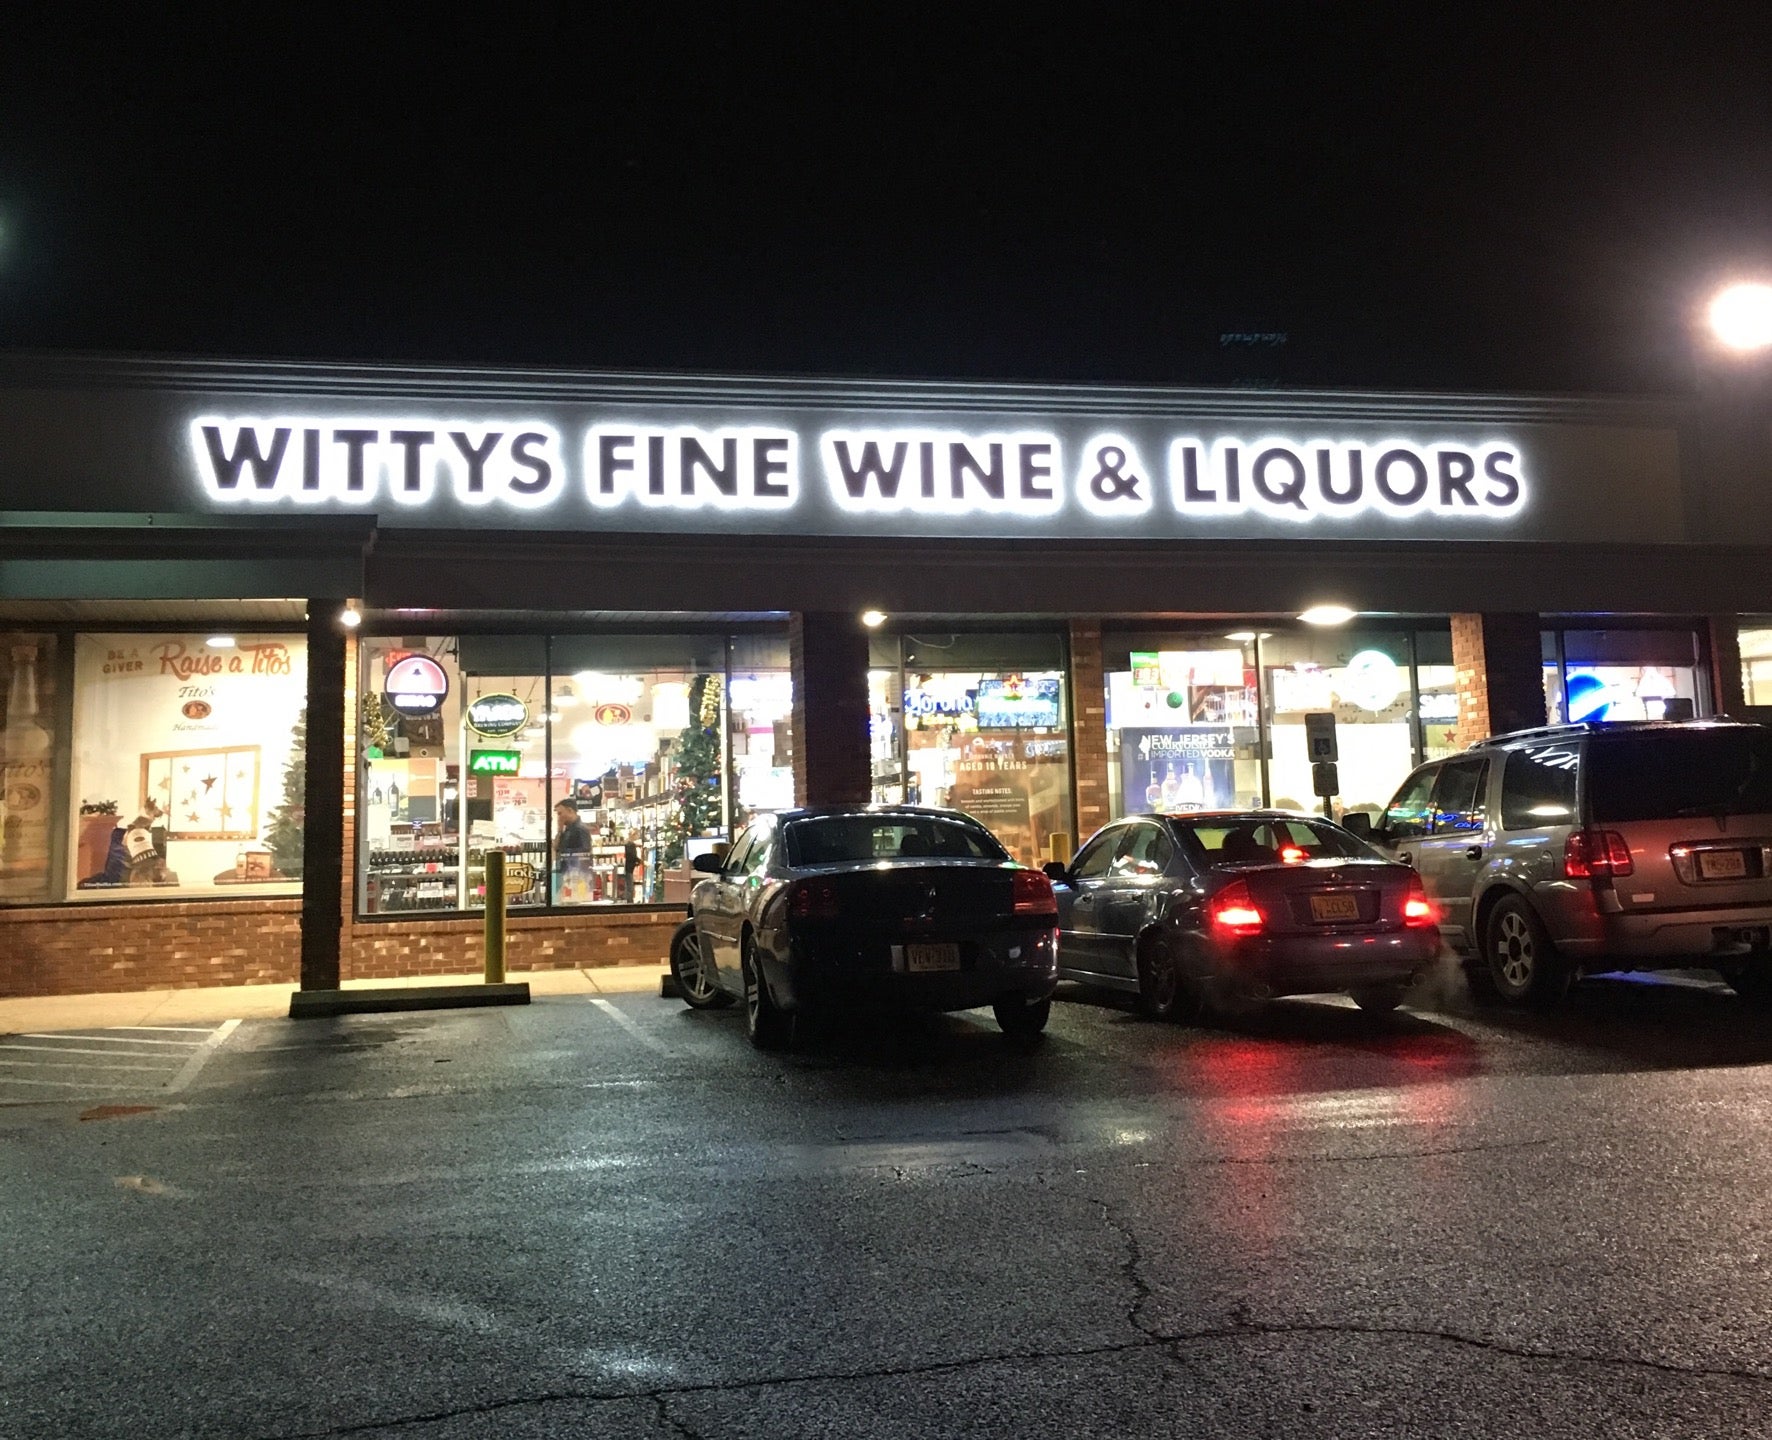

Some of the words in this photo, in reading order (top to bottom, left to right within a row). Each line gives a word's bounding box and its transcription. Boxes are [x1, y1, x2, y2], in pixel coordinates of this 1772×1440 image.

[200, 425, 553, 494] WITTYS
[599, 434, 790, 498] FINE
[832, 439, 1054, 500] WINE
[1089, 444, 1144, 502] &
[1182, 445, 1521, 511] LIQUORS
[102, 660, 144, 675] GIVER
[151, 640, 223, 682] Raise
[229, 655, 244, 674] a
[178, 685, 216, 698] Tito's
[1142, 734, 1174, 744] NEW
[1178, 733, 1235, 745] JERSEY'S
[1151, 750, 1199, 759] IMPORTED
[1201, 749, 1235, 759] VODKA
[473, 757, 517, 771] ATM
[959, 761, 983, 772] AGED
[997, 760, 1027, 771] YEARS
[506, 867, 541, 880] TICKET
